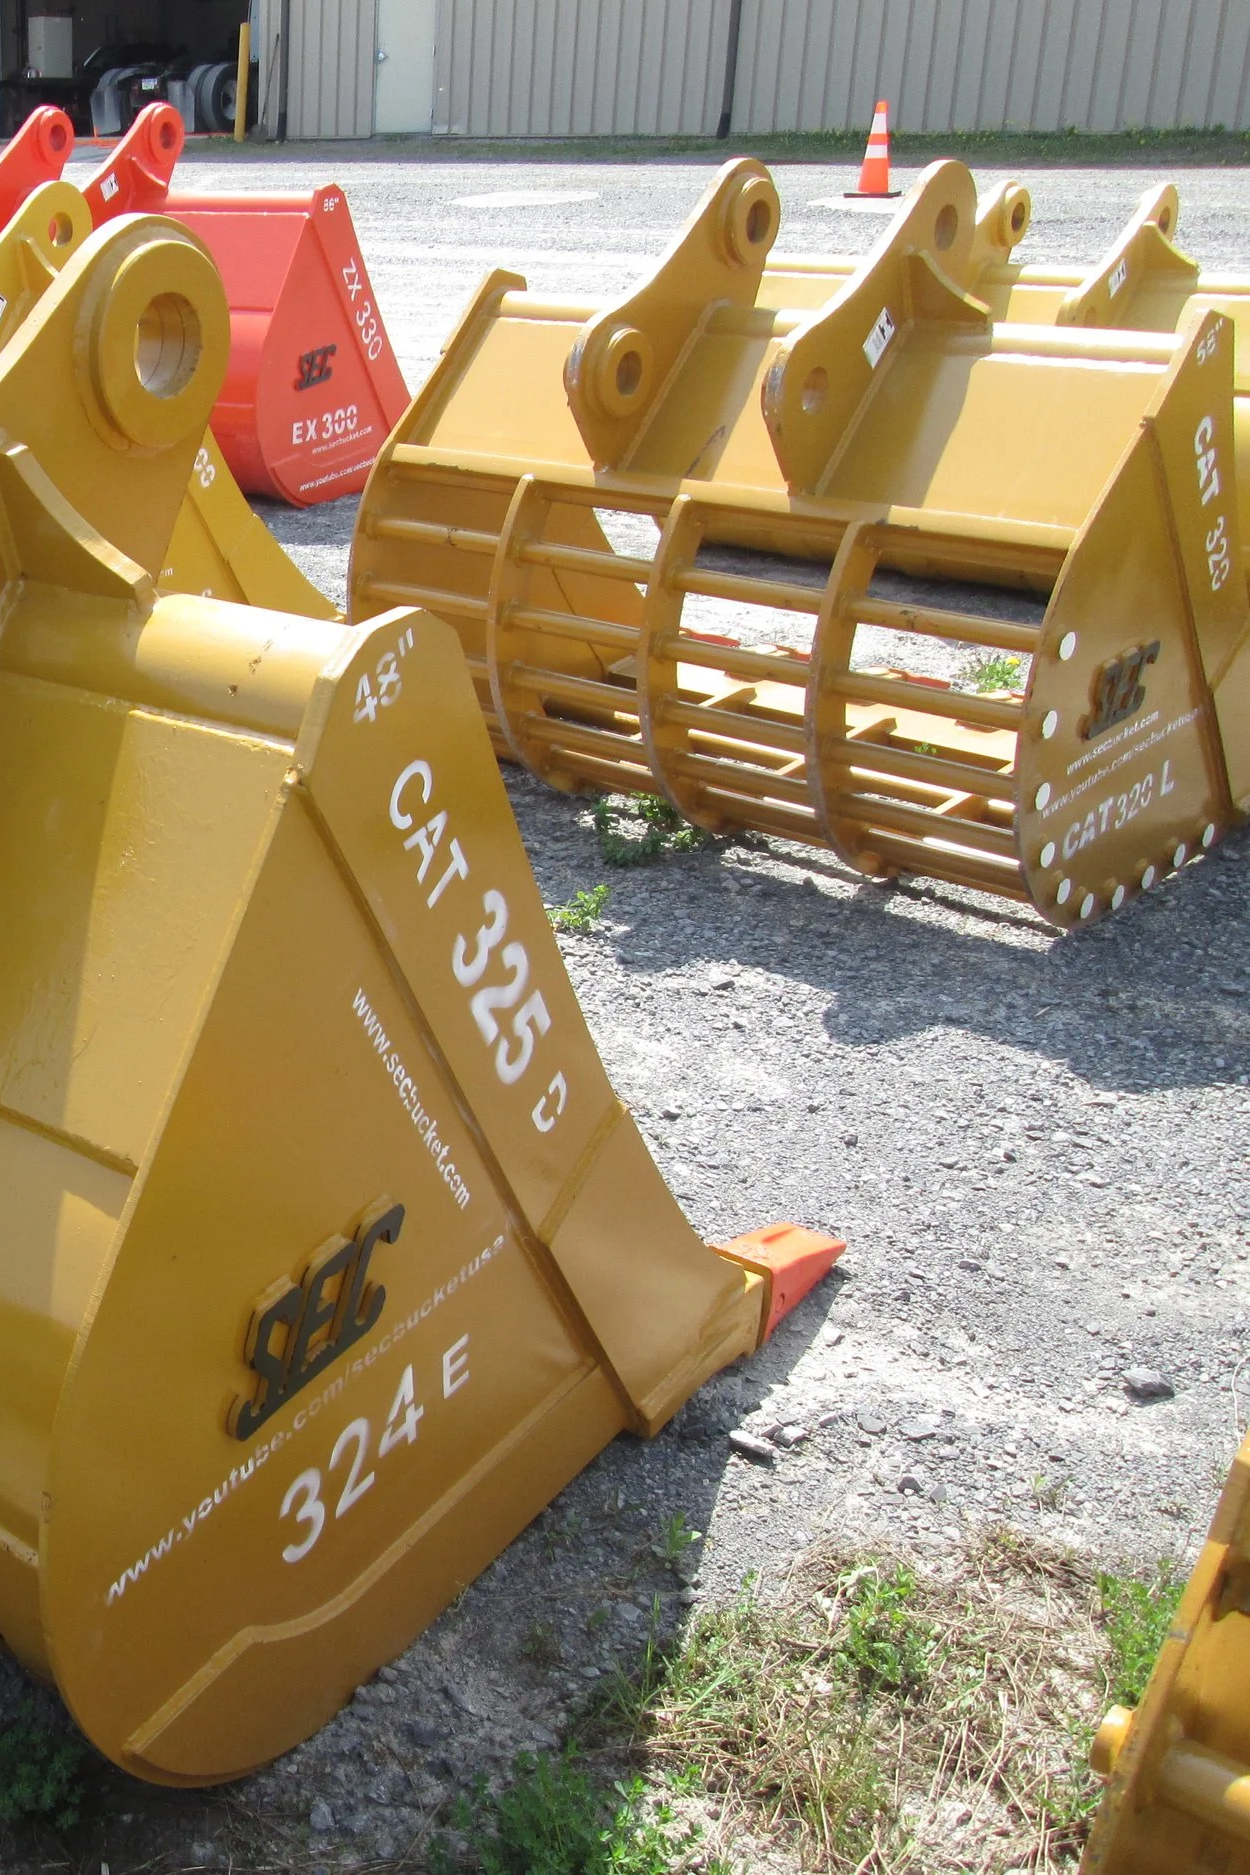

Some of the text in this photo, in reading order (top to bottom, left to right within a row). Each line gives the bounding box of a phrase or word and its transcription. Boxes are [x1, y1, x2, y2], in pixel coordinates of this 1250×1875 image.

[342, 257, 383, 361] ZX 330
[294, 344, 337, 392] SEC
[292, 404, 358, 445] EX 300
[1194, 415, 1220, 507] CAT
[353, 626, 414, 724] 48"
[1062, 759, 1175, 860] CAT 320 L
[389, 759, 470, 909] CAT
[452, 889, 551, 1085] 325
[352, 987, 470, 1211] www.secbucket.com
[228, 1197, 406, 1441] SEC
[279, 1332, 470, 1563] 324 E
